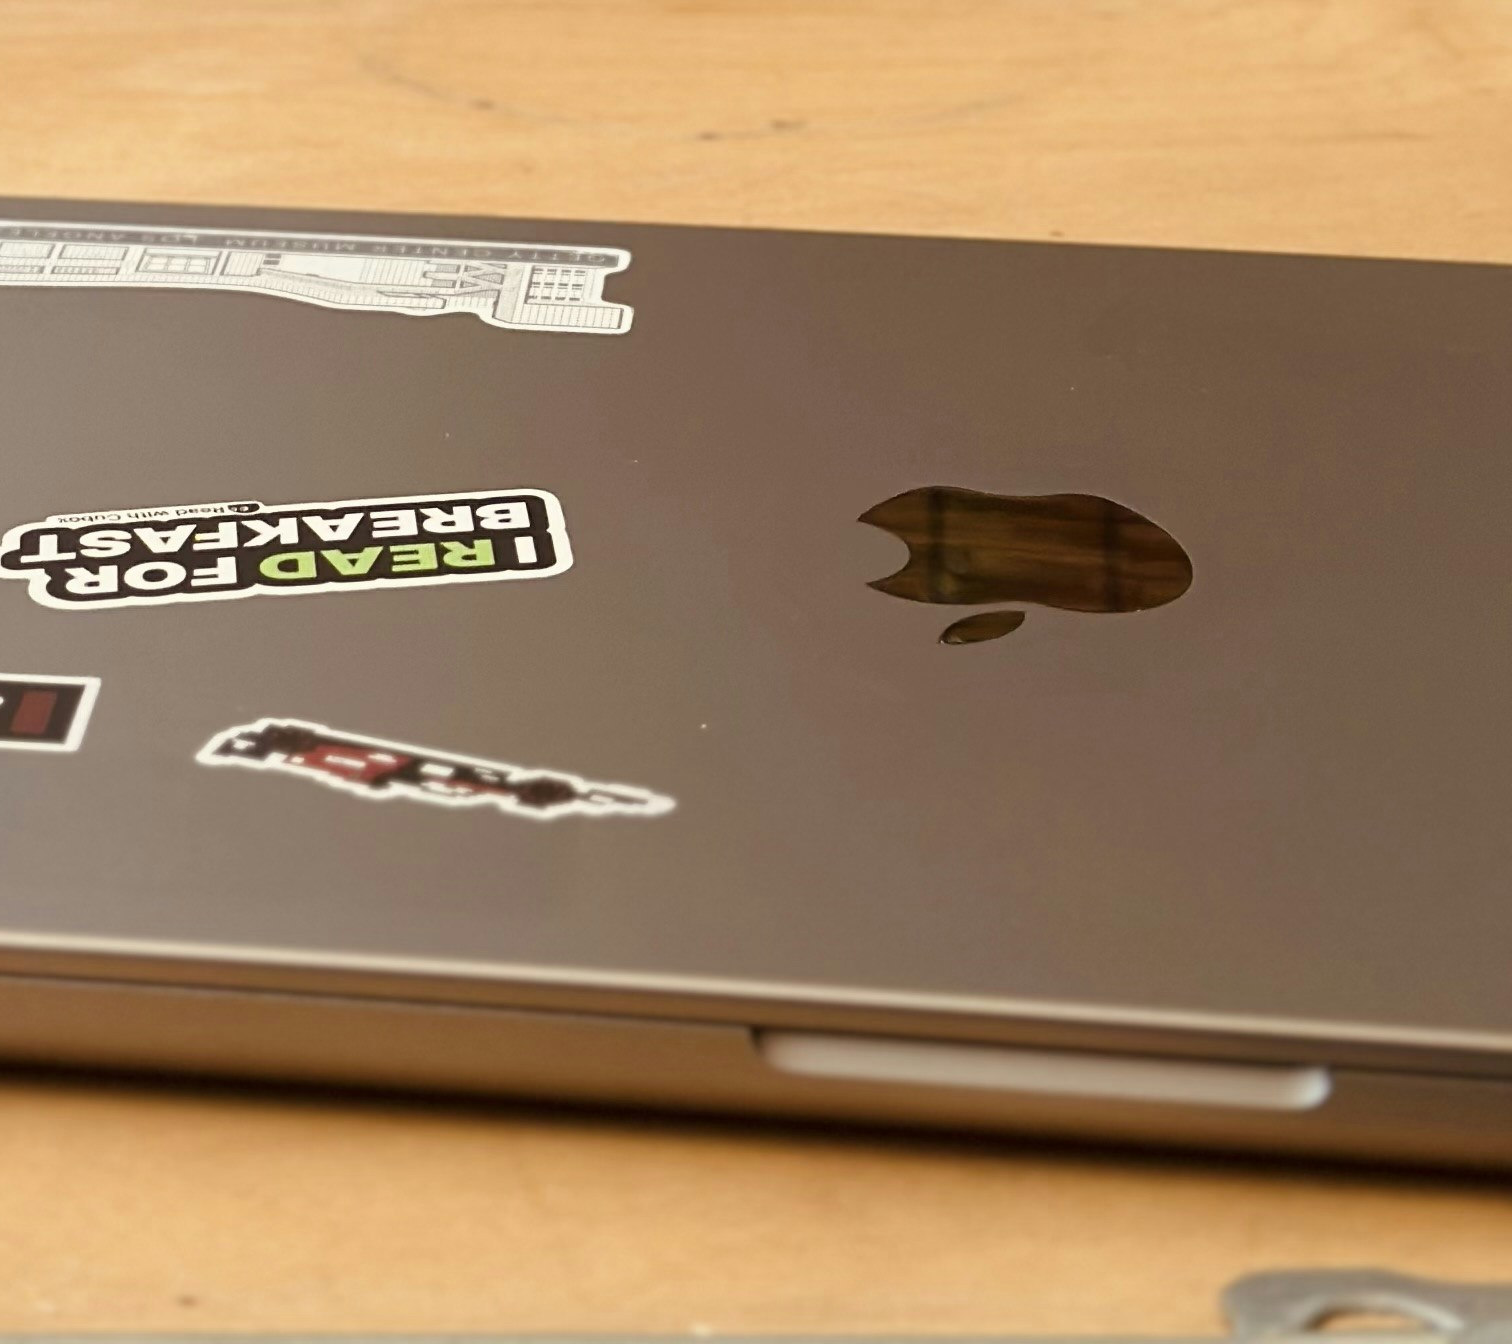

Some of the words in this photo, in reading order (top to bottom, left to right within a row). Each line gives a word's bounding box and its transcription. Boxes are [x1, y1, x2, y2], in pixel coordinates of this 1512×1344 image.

[141, 232, 198, 246] LOS
[226, 237, 356, 252] MUSEUM
[372, 243, 490, 258] CENTER
[126, 510, 169, 520] with
[174, 506, 225, 517] Read
[56, 514, 121, 526] Cubox
[20, 502, 530, 564] BREAKFAST
[514, 536, 536, 564] I
[259, 538, 496, 580] READ
[58, 556, 238, 595] FOR
